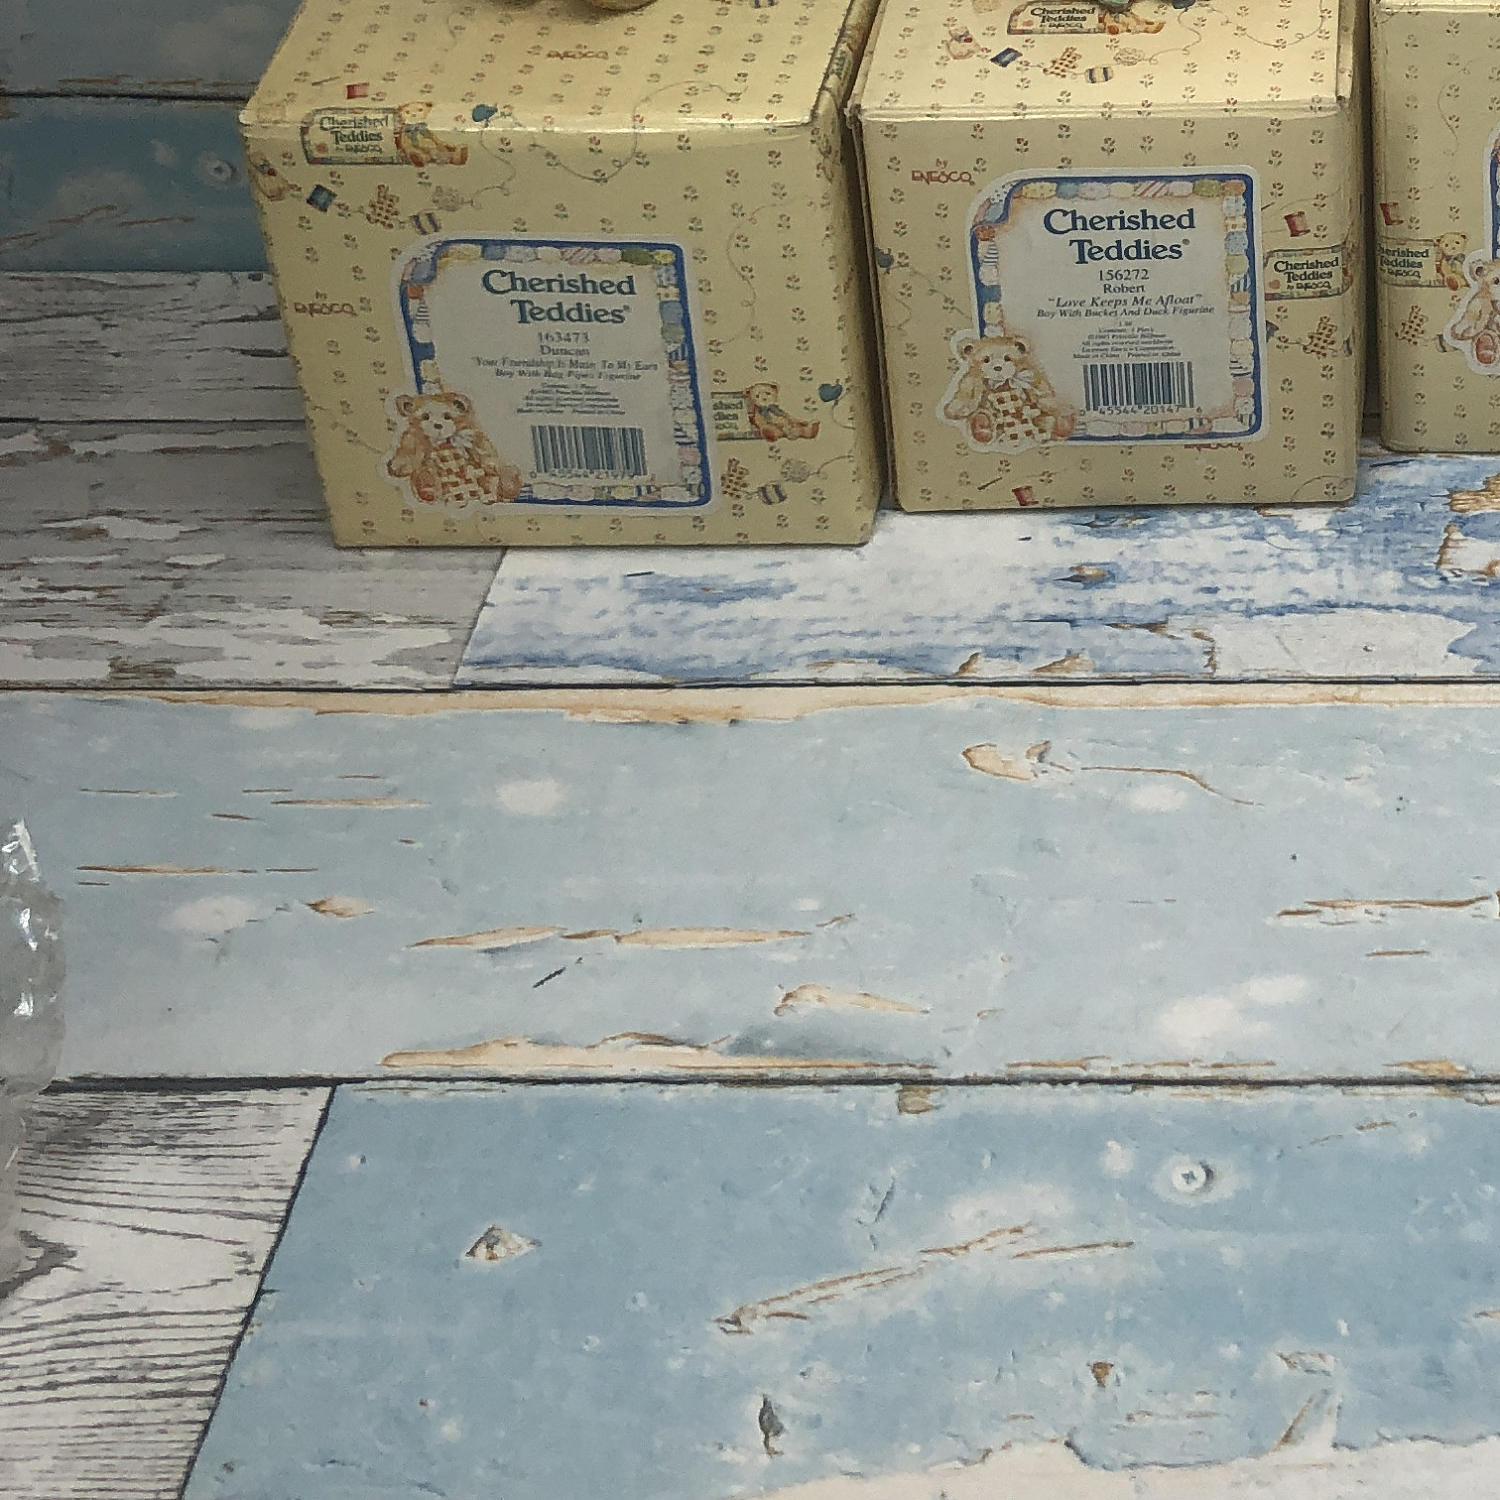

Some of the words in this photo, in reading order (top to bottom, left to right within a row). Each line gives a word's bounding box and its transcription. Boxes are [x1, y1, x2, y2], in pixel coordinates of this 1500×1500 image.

[1030, 7, 1096, 17] Cherished
[1040, 15, 1087, 23] Teddies
[320, 116, 388, 131] Cherished
[331, 130, 383, 143] Teddies
[1043, 208, 1196, 235] Cherished
[1069, 238, 1184, 265] Teddies
[1274, 257, 1339, 272] Cherished
[1099, 269, 1150, 281] 156272
[1284, 270, 1333, 283] Teddies
[482, 269, 637, 295] Cherished
[1103, 283, 1146, 294] Robert
[1091, 296, 1128, 309] Keeps
[1131, 296, 1152, 306] Me
[510, 299, 626, 324] Teddies
[1037, 308, 1055, 319] Boy
[1059, 307, 1082, 318] With
[1084, 307, 1118, 318] Bucket
[1120, 307, 1141, 316] And
[1143, 306, 1169, 316] Duck
[1172, 305, 1215, 316] Figurine
